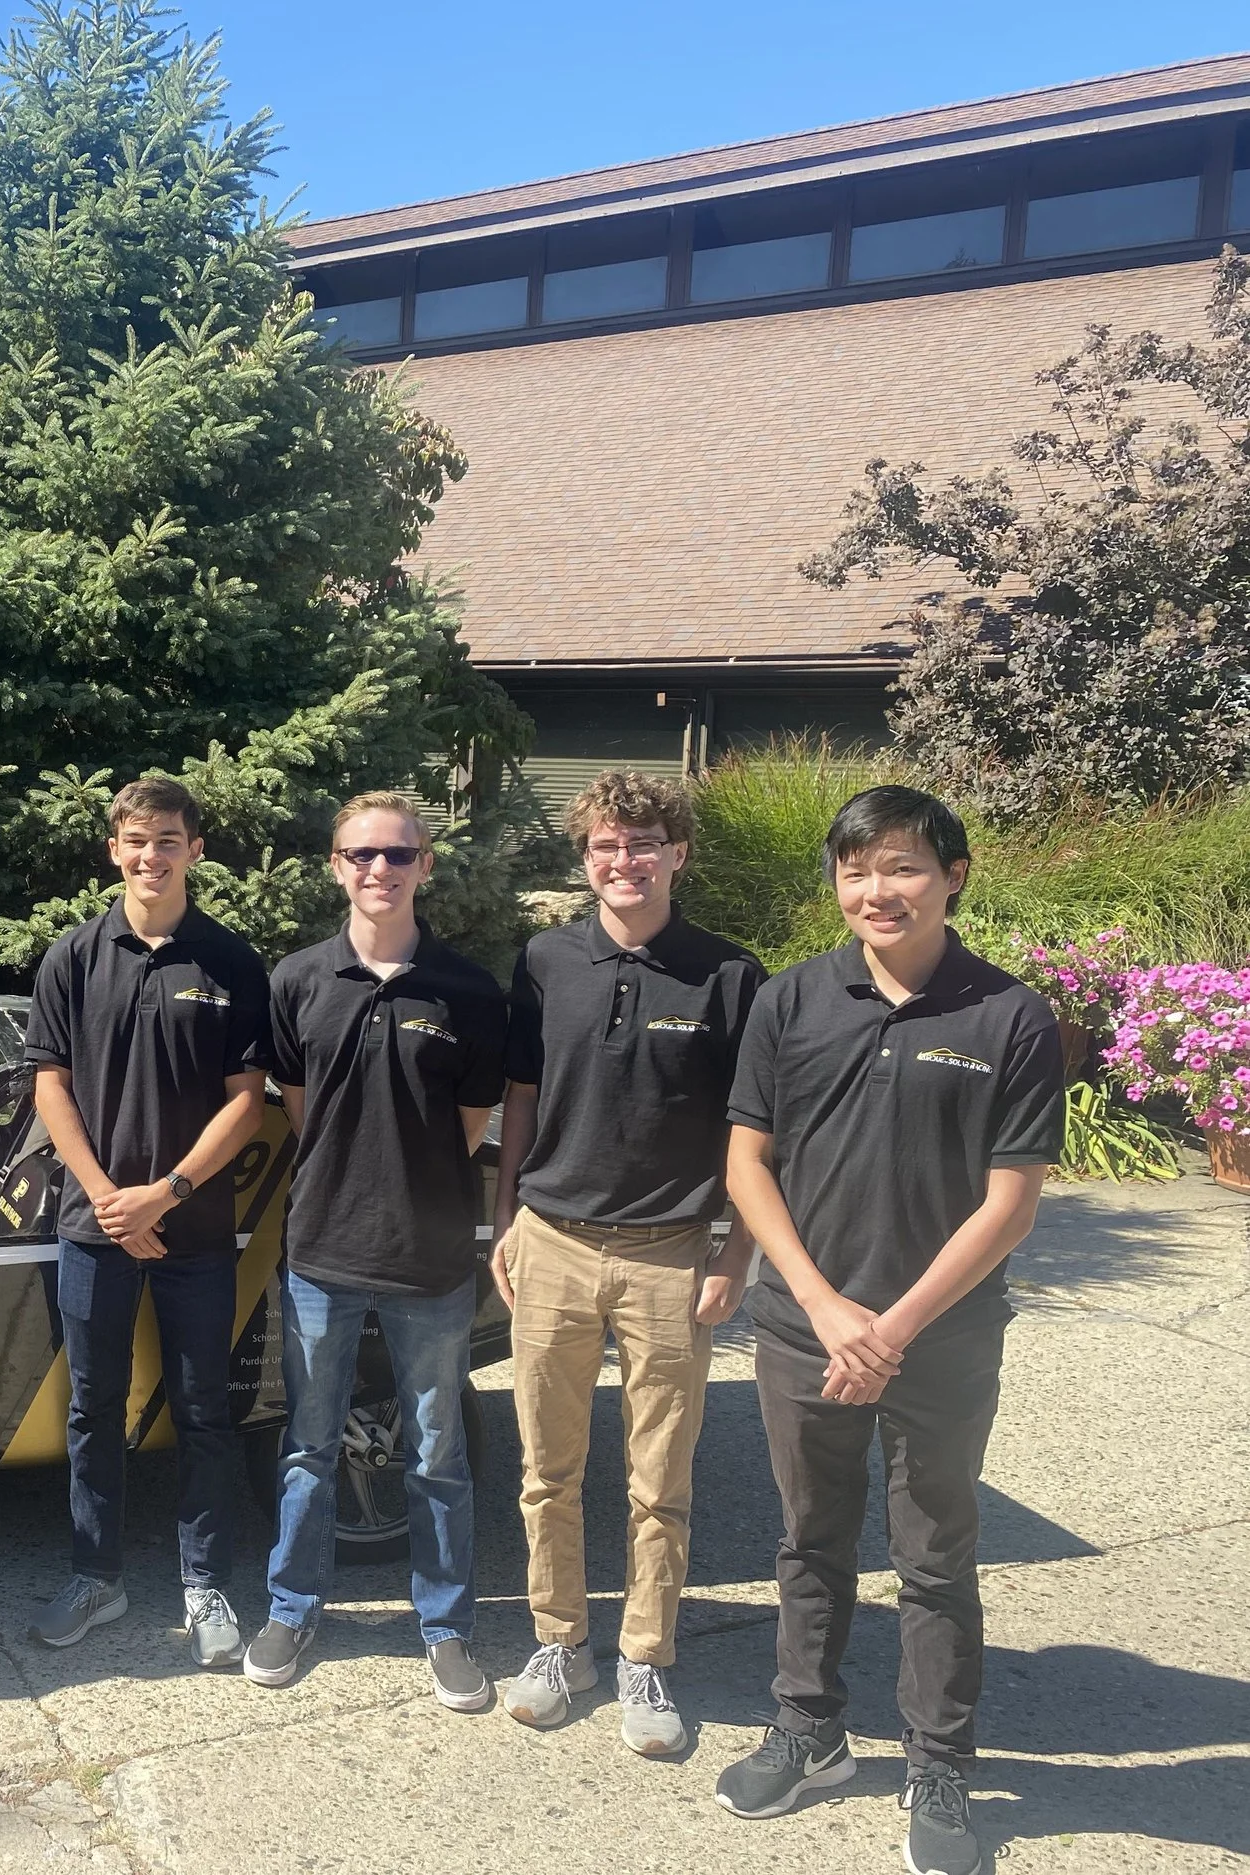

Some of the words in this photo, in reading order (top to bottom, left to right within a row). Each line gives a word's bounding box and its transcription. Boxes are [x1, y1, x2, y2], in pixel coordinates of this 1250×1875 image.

[252, 1333, 280, 1343] School
[362, 1326, 379, 1336] ring
[240, 1356, 269, 1366] Purdue
[252, 1381, 261, 1390] of
[262, 1379, 276, 1388] the
